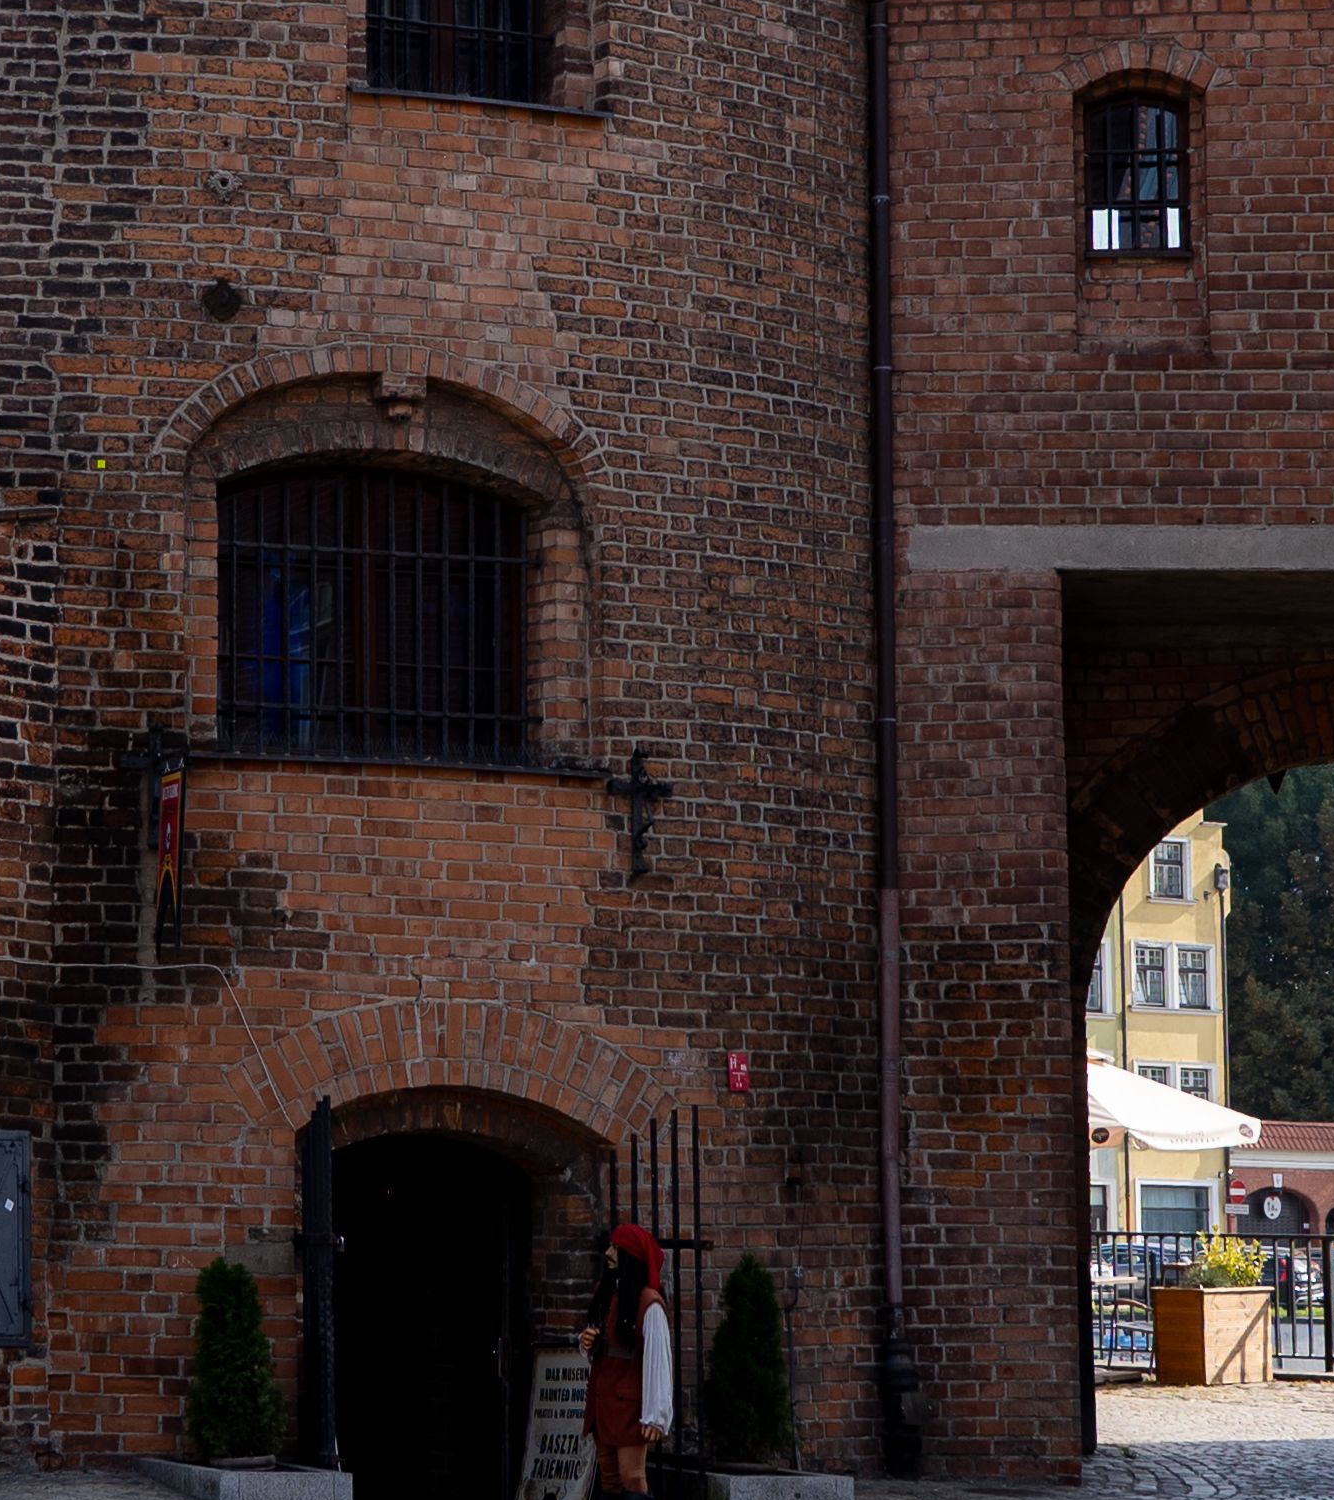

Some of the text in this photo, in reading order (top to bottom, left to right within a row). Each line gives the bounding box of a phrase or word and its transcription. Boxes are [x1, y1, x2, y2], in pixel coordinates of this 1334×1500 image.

[539, 1387, 588, 1402] HAUNTED HOUS
[539, 1433, 579, 1455] BASZTA
[531, 1458, 581, 1480] TAJEMNIC
